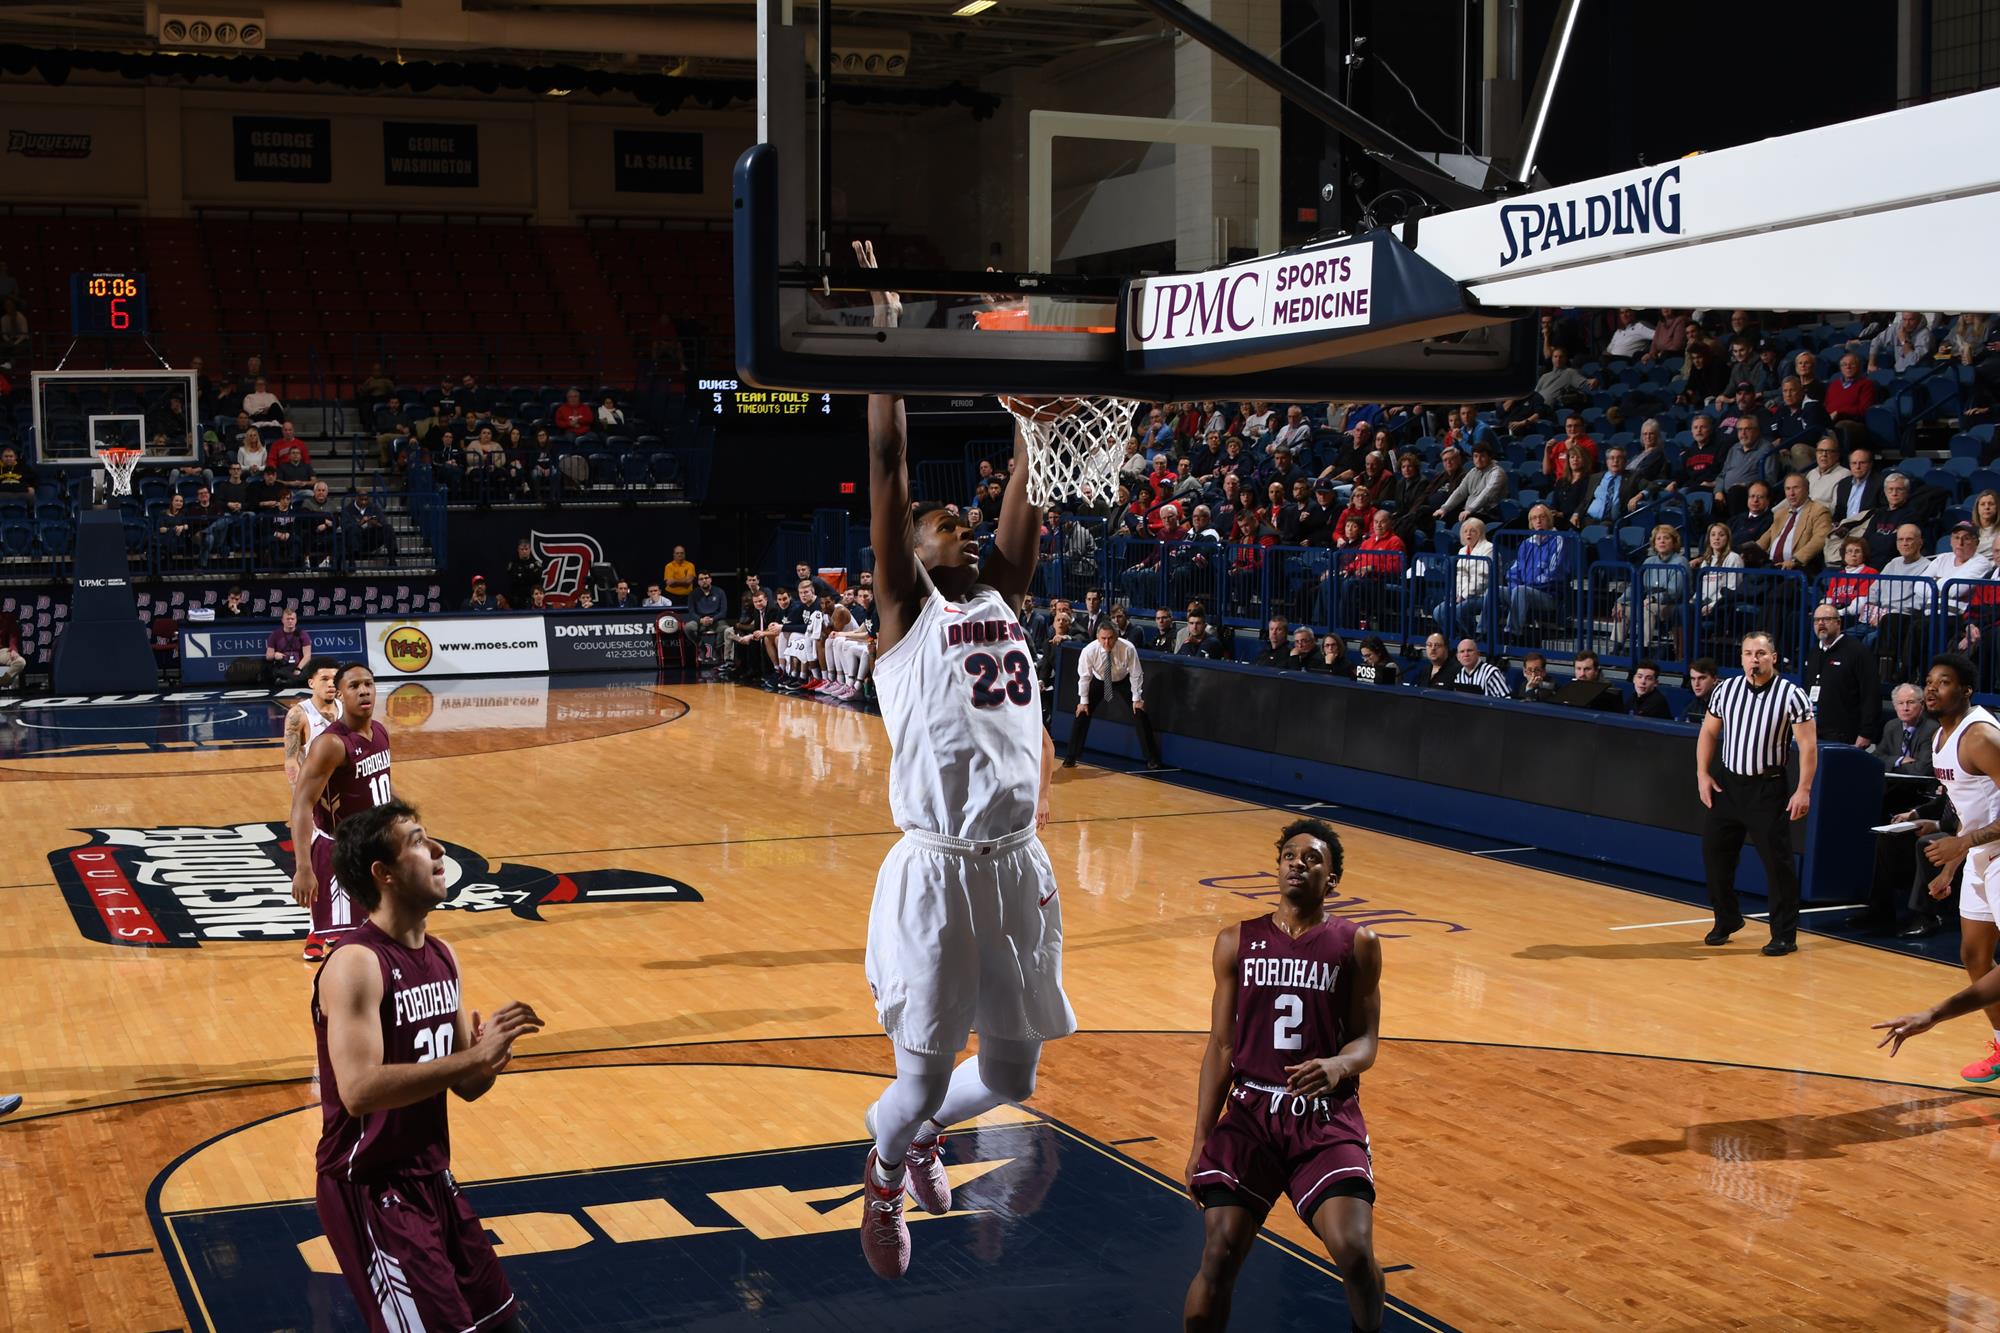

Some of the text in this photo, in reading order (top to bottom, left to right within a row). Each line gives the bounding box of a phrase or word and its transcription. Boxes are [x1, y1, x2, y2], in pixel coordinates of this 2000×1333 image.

[9, 131, 89, 151] DUQUESNE
[250, 130, 315, 148] GEORGE
[408, 137, 456, 152] GEORGE
[253, 152, 313, 169] MASON
[391, 158, 473, 174] WASHINGTON
[624, 154, 694, 171] LA SALLE
[1500, 165, 1681, 267] SPALDING
[1275, 255, 1352, 291] SPORTS
[88, 278, 137, 297] 10:06
[111, 298, 129, 329] 6
[1130, 272, 1260, 343] UPMC
[1272, 288, 1369, 326] MEDICINE
[698, 379, 739, 390] DUKES
[713, 392, 831, 403] 5 TEAM FOULS 4
[713, 404, 831, 414] 4 TIMEOUTS LEFT 4
[840, 482, 855, 494] EXIT
[79, 579, 106, 587] UPMC
[554, 624, 604, 638] DON'T
[604, 623, 644, 636] MISS
[216, 637, 354, 650] SCHNEI OWNS
[439, 639, 539, 652] www.moes.com
[964, 649, 1033, 710] 23
[1356, 665, 1376, 679] POSS
[368, 773, 391, 808] 10
[76, 852, 154, 937] DUKES
[1243, 957, 1341, 993] FORDHAM
[394, 978, 459, 1027] FORDHAM
[1273, 993, 1303, 1050] 2
